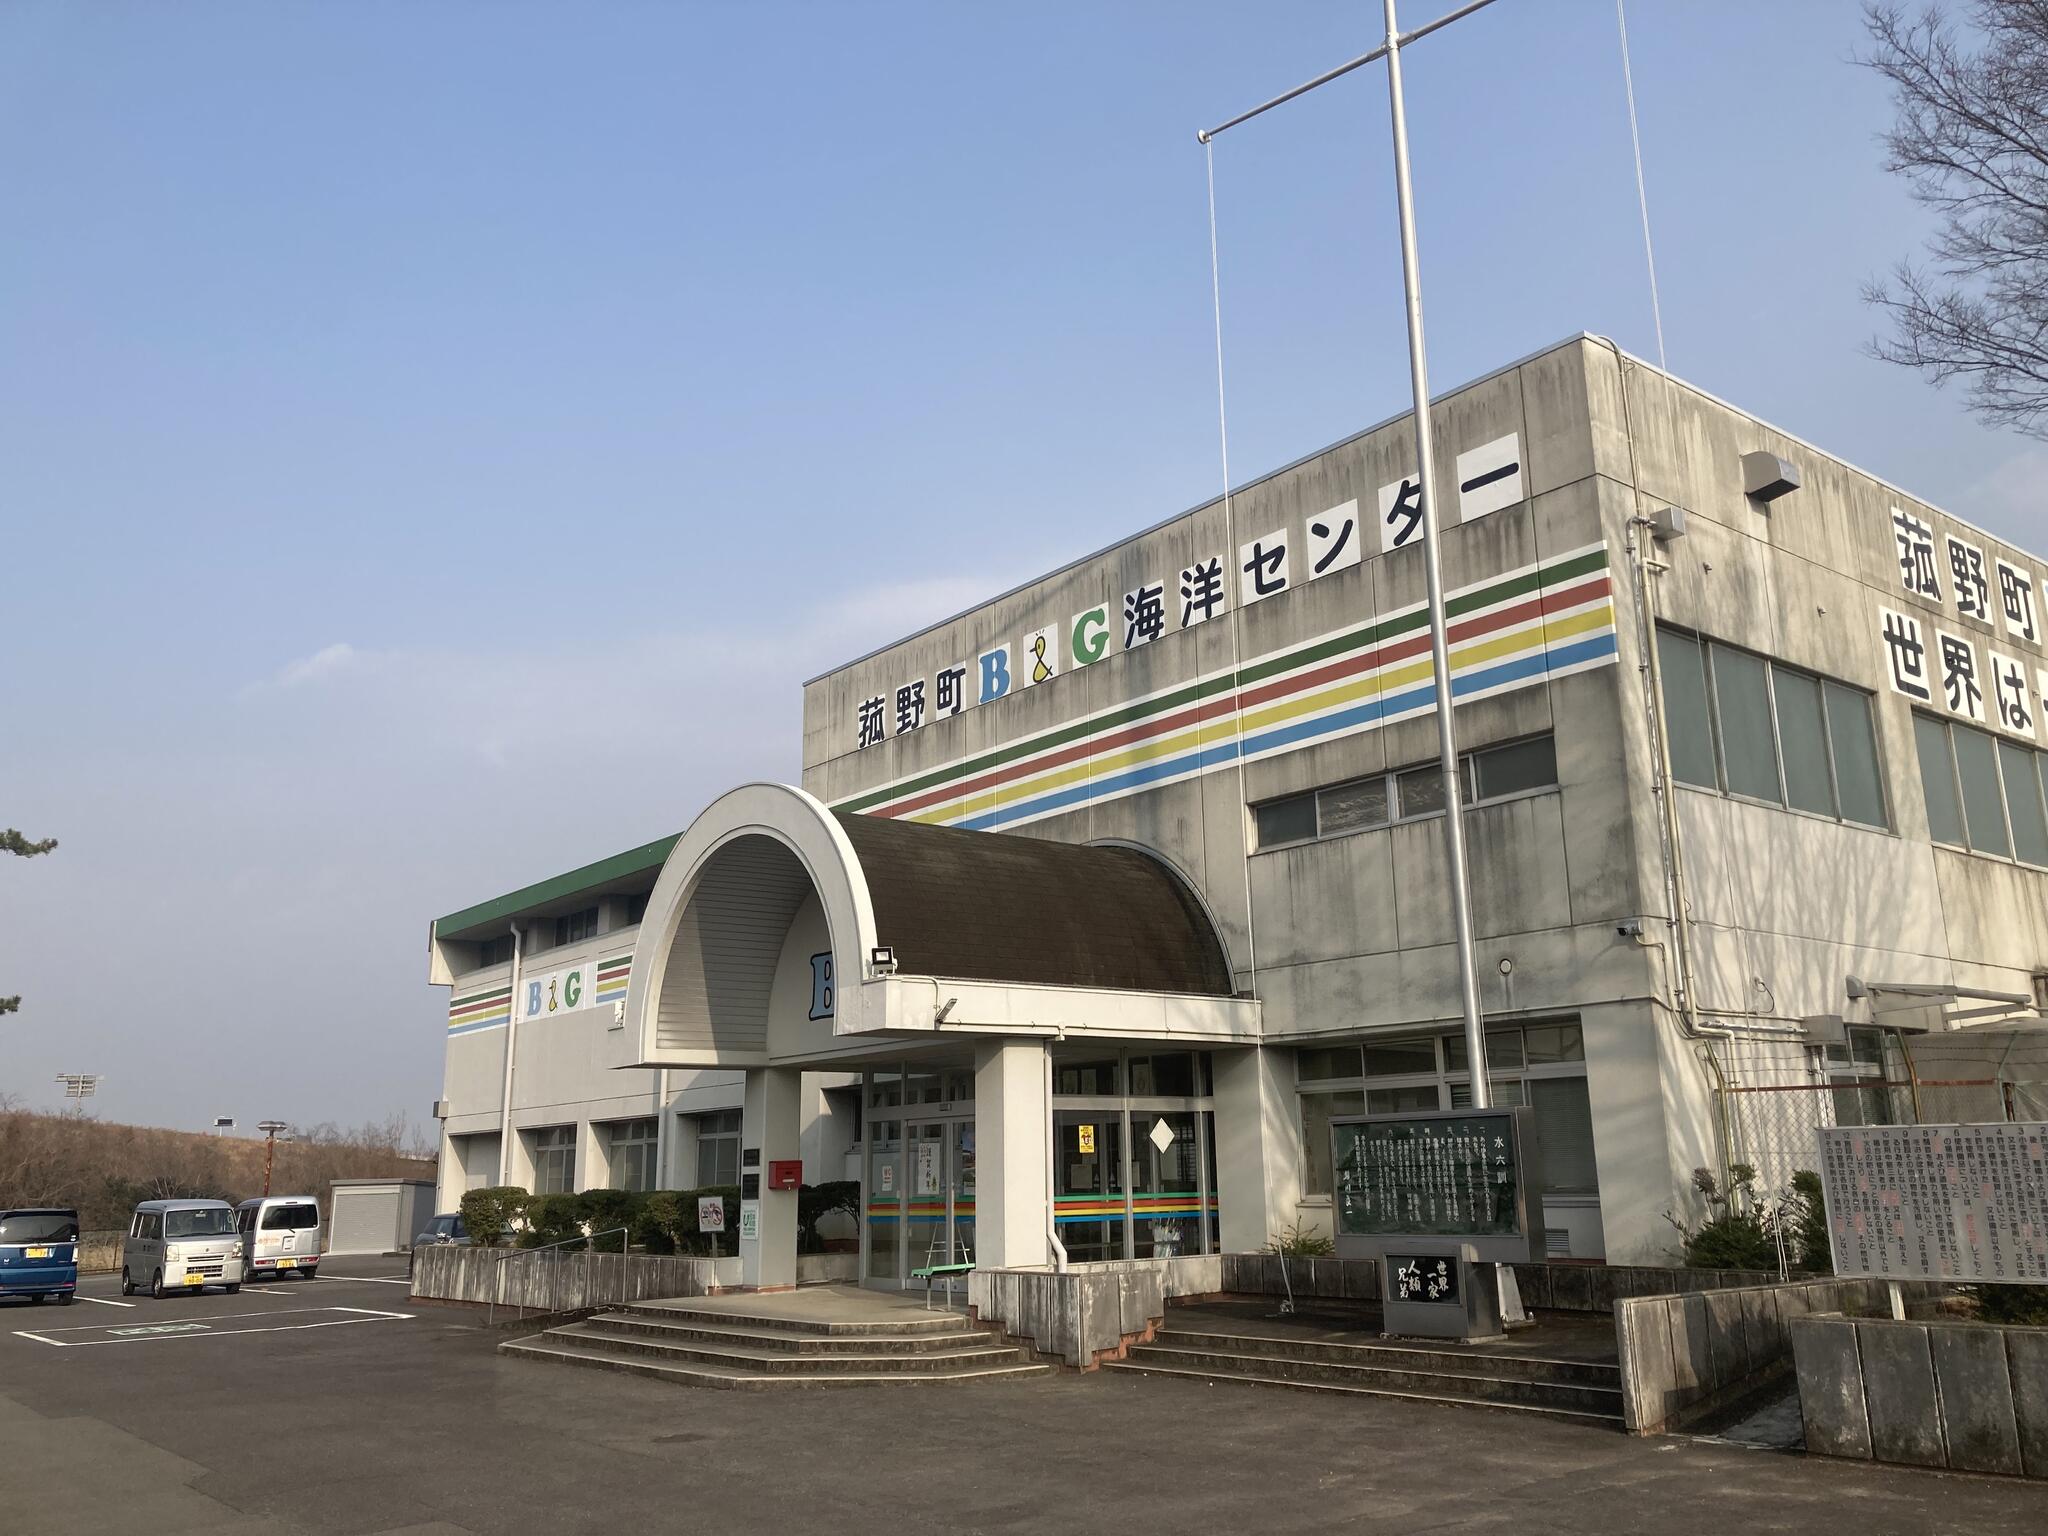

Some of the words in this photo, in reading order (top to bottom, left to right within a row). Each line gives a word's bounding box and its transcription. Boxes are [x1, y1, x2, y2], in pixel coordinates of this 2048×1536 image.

[1893, 513, 2048, 641] 菰野町
[1883, 612, 2048, 729] 世界は
[1922, 1129, 1929, 1137] 8
[1994, 1127, 2002, 1135] 4
[1437, 1260, 1449, 1292] 世界
